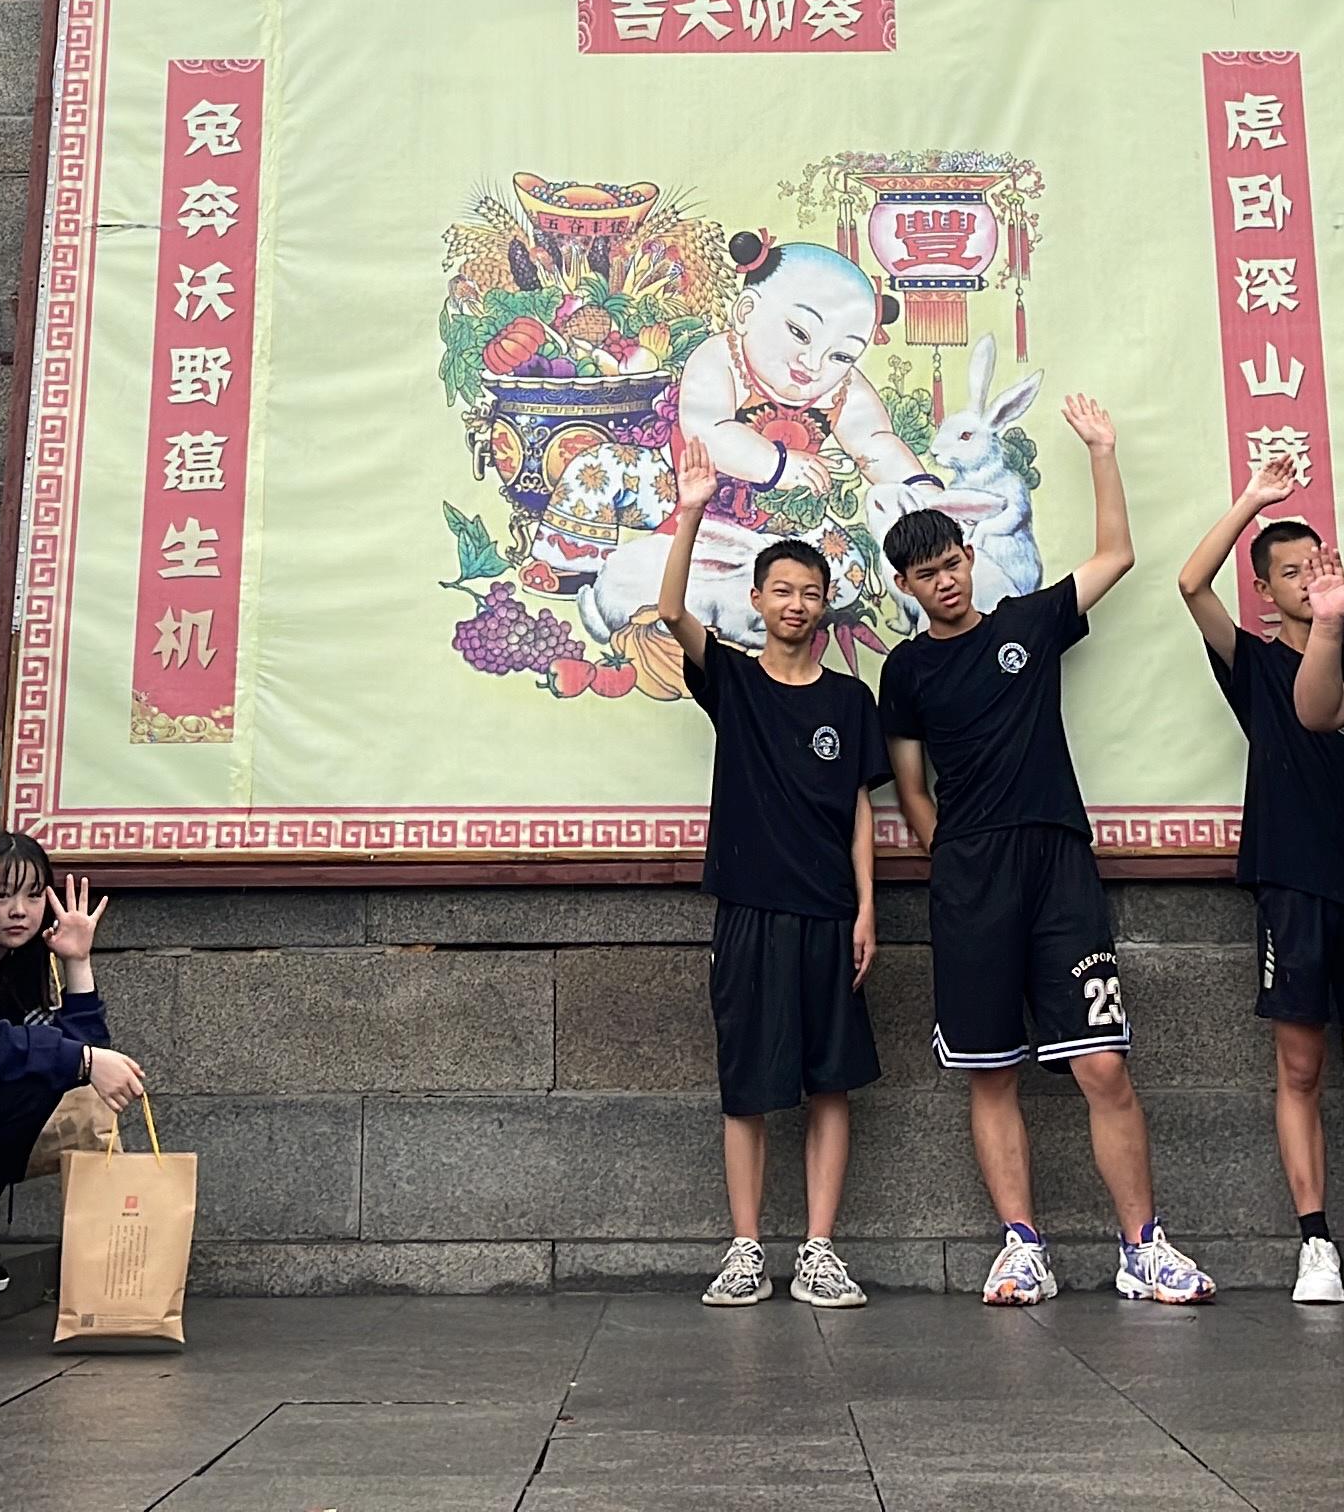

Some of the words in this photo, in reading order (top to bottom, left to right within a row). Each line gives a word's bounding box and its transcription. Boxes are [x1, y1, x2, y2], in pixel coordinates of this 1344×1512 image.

[152, 99, 242, 670] 兔奔沃野蕴生机
[1224, 92, 1314, 642] 虎卧深山藏
[1084, 976, 1125, 1027] 23
